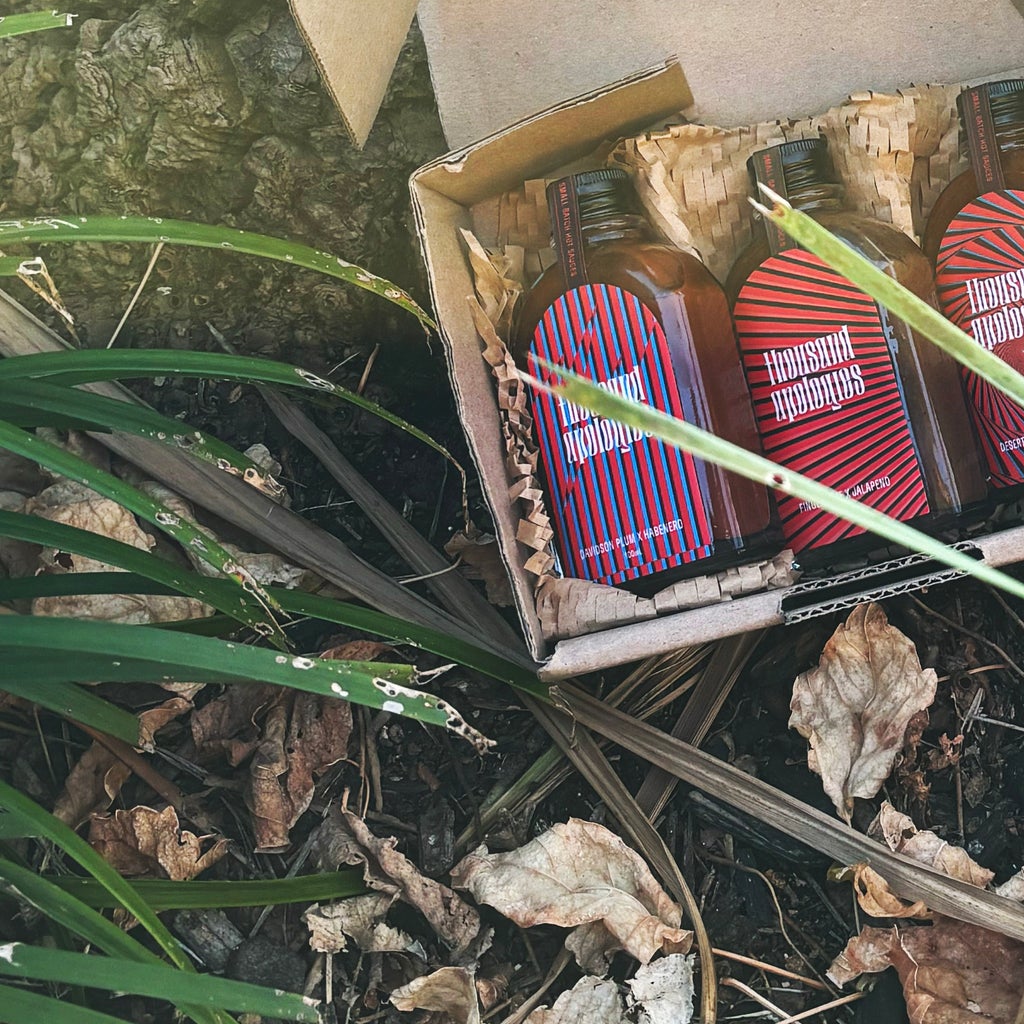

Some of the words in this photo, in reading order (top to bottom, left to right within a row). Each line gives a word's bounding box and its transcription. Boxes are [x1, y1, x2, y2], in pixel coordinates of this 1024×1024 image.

[762, 324, 856, 387] thousand
[770, 363, 866, 423] apologies
[844, 488, 851, 499] X
[851, 476, 891, 497] JALAPENO
[580, 540, 615, 561] DAVIDSON
[615, 534, 637, 549] PLUM
[637, 531, 644, 542] X
[643, 519, 684, 540] HABENERO
